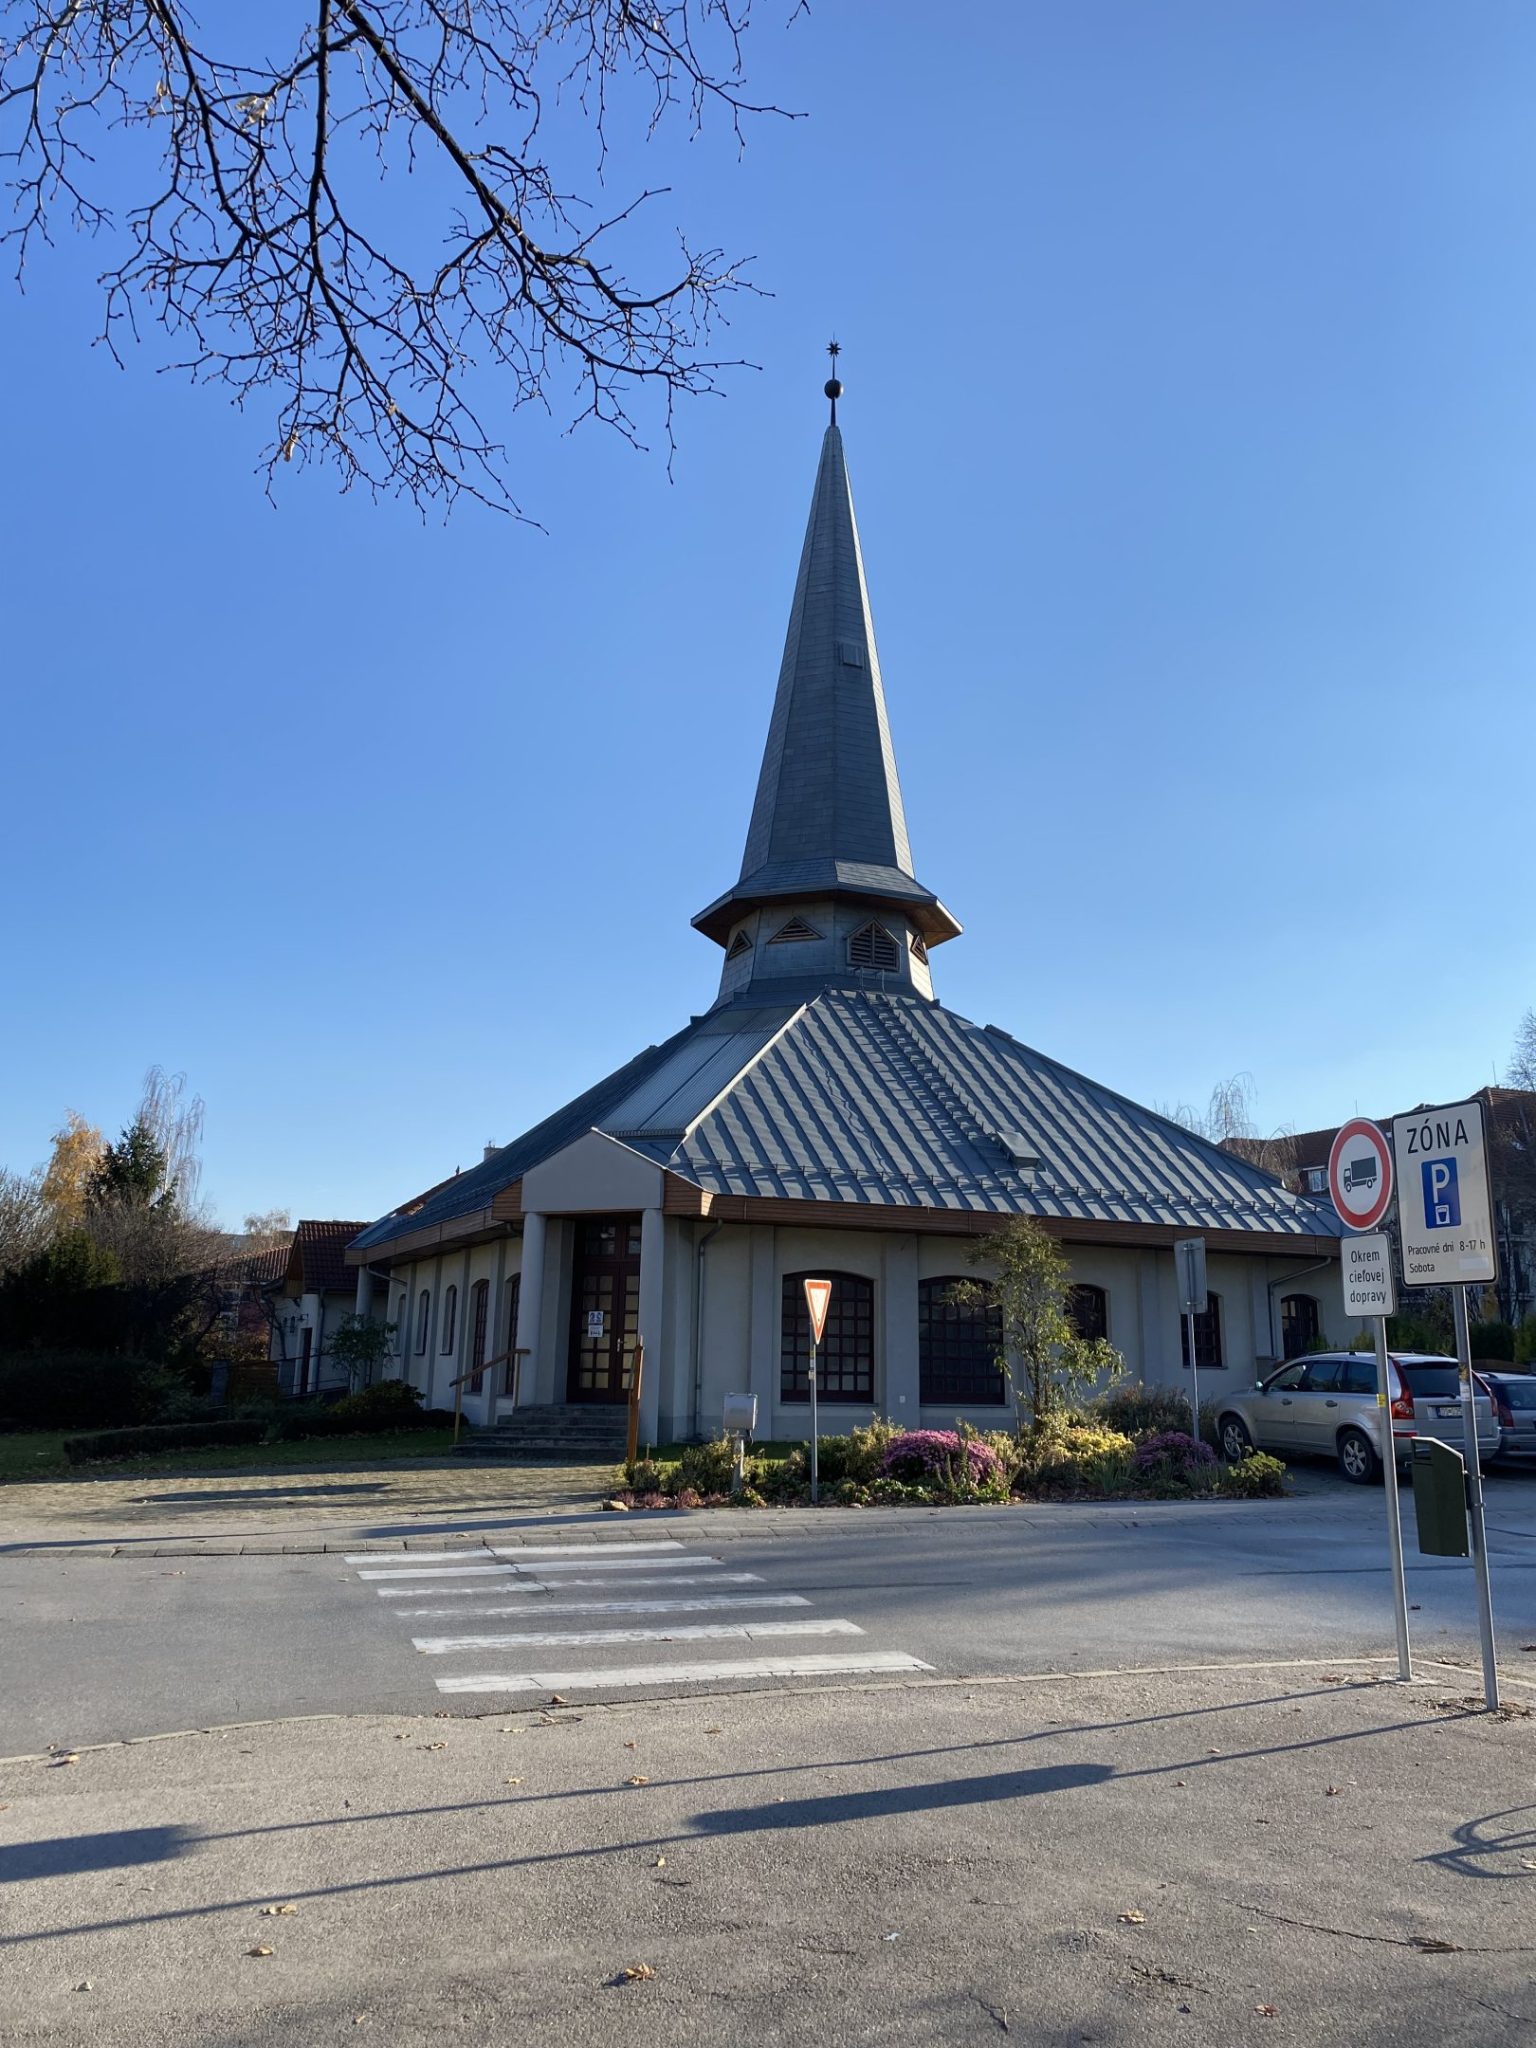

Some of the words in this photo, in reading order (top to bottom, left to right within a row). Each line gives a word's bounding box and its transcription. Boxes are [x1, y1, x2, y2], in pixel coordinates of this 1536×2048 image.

[1406, 1117, 1469, 1154] ZÓNA
[1431, 1163, 1450, 1204] P
[1408, 1242, 1440, 1256] Pracovné
[1442, 1241, 1455, 1253] dni
[1479, 1239, 1486, 1250] h
[1350, 1250, 1380, 1263] Okrem
[1409, 1263, 1435, 1274] Sobota
[1350, 1290, 1387, 1305] dopravy
